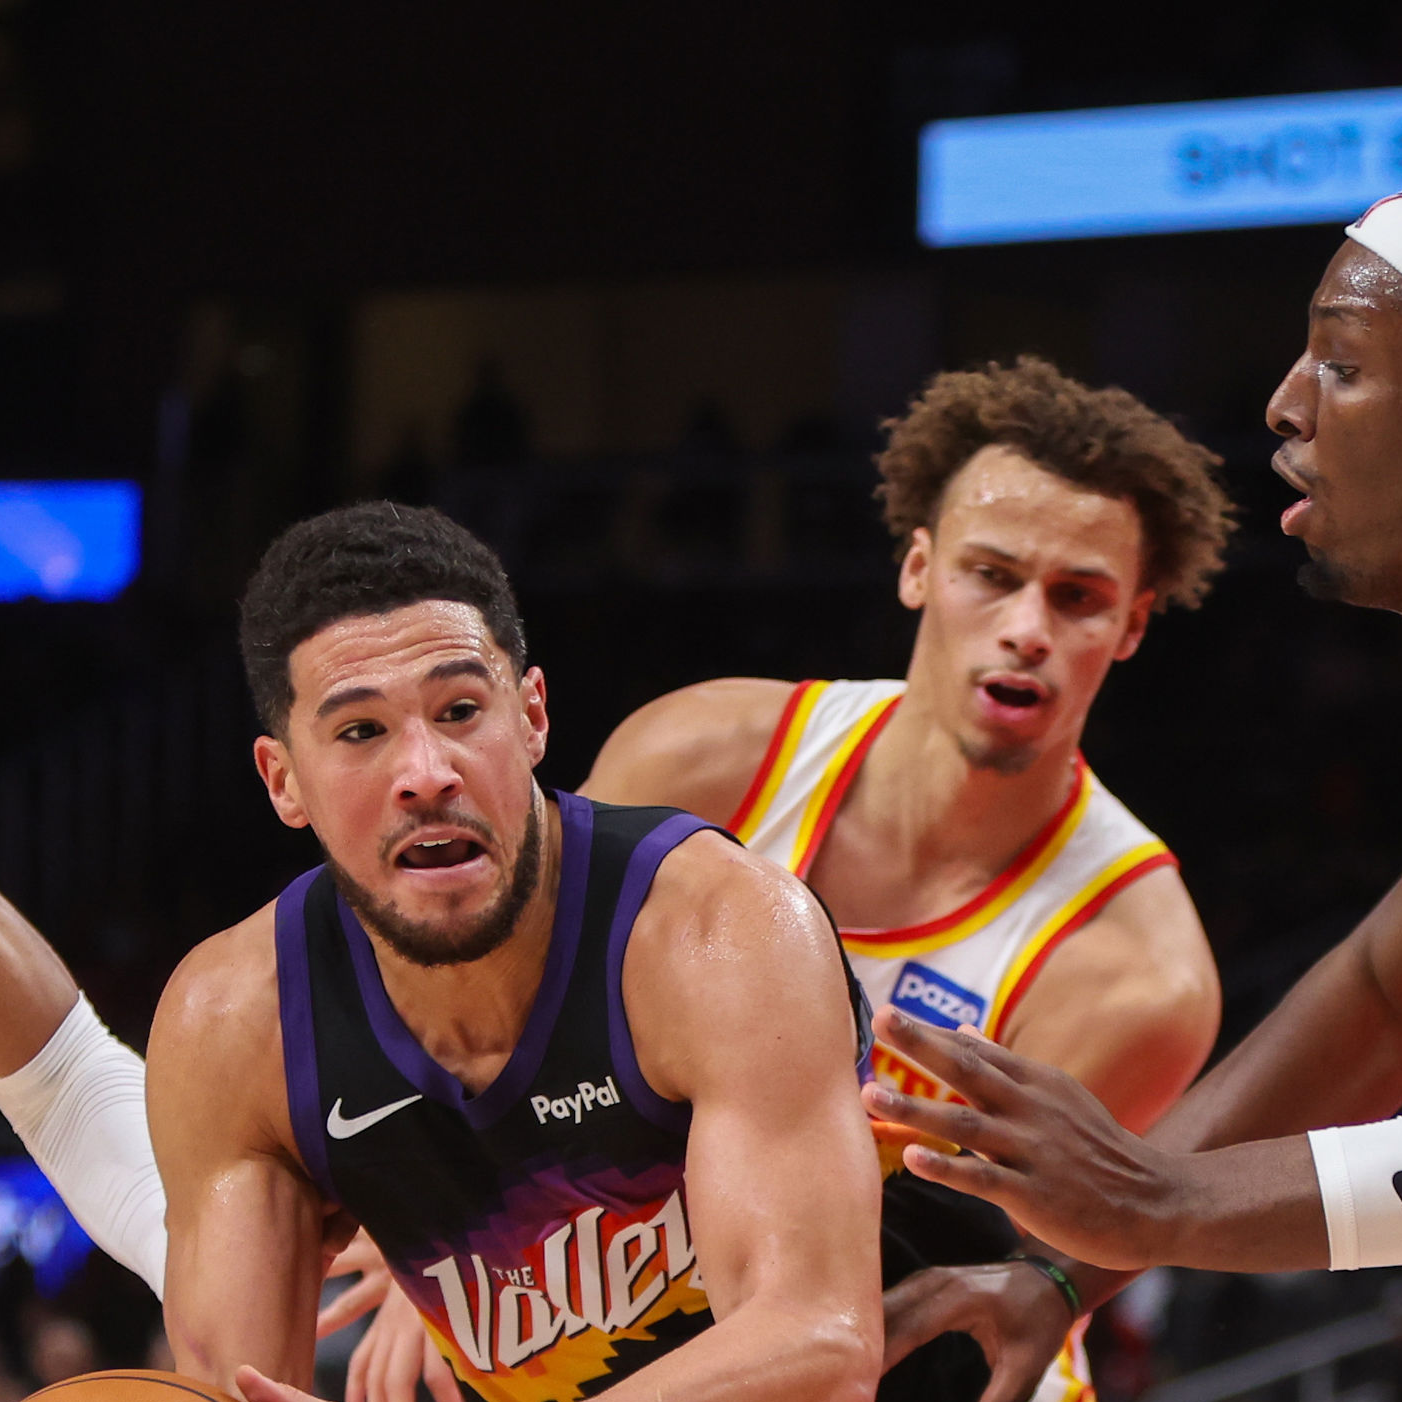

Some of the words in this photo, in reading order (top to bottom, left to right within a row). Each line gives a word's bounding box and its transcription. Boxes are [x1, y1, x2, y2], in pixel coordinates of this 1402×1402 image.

[897, 972, 980, 1025] paze
[530, 1076, 621, 1125] PayPal
[491, 1265, 535, 1287] THE
